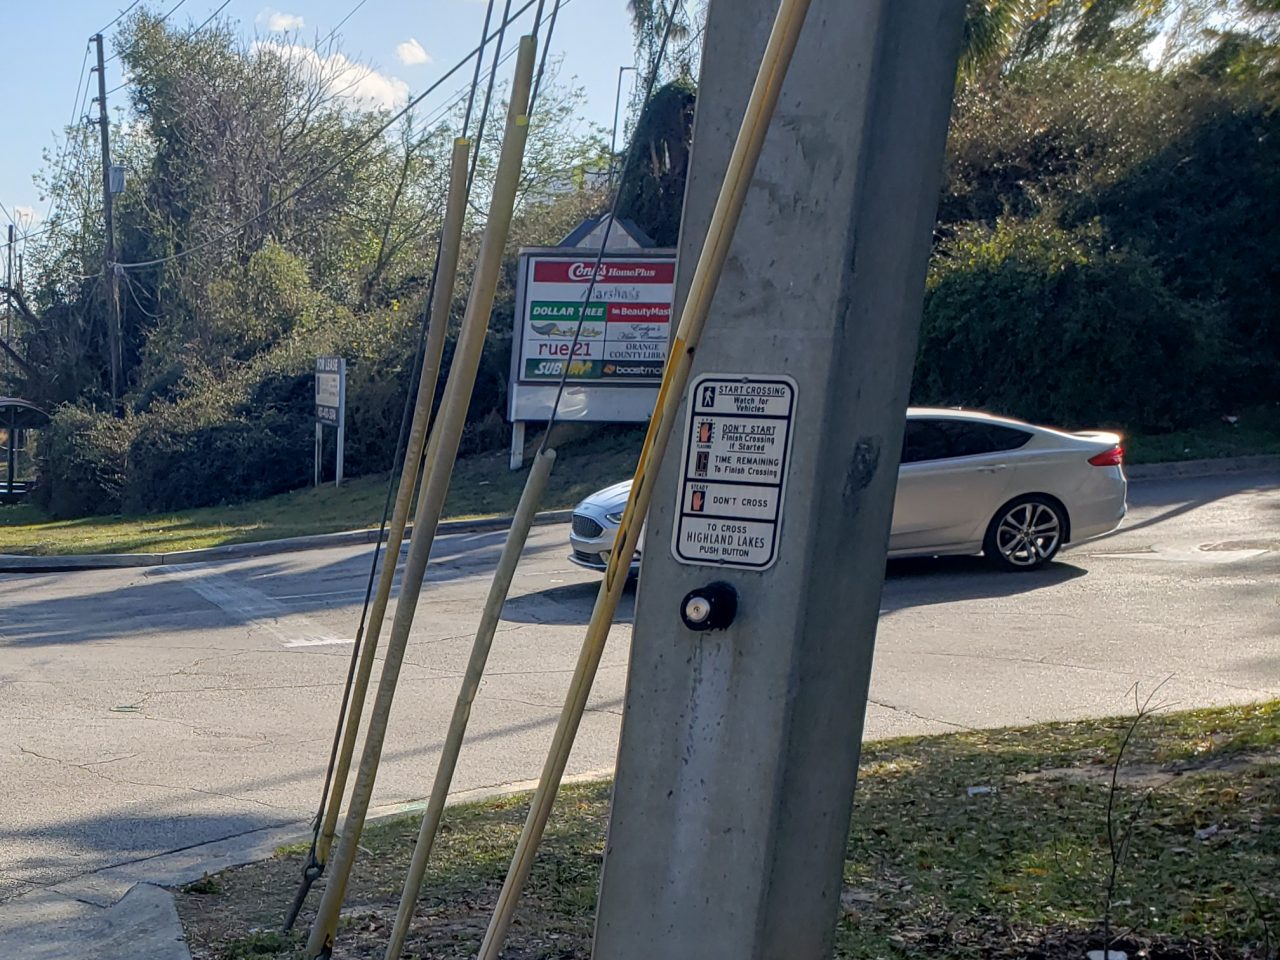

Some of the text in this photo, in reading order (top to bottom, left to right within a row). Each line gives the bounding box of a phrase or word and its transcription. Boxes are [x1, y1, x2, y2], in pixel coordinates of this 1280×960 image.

[608, 268, 656, 277] HomePlus
[532, 306, 575, 316] DOLLAR
[578, 307, 604, 316] TREE
[621, 307, 671, 317] BeautyMast
[625, 343, 659, 351] ORANGE
[609, 351, 641, 359] COUNTY
[616, 365, 664, 375] boostmo
[718, 385, 786, 396] START CROSSING
[733, 396, 755, 404] Watch
[736, 405, 766, 413] Vehicles
[722, 424, 777, 435] DON'T START
[744, 434, 775, 445] Crossing
[738, 442, 765, 452] Started
[715, 455, 733, 464] TIME
[736, 456, 779, 467] REMAINING
[714, 465, 778, 479] To Finish Crossing
[713, 496, 768, 508] DON'T CROSS
[707, 523, 748, 534] TO CROSS
[686, 531, 765, 549] HIGHLAND LAKES
[699, 545, 750, 558] PUSH BUTTON
